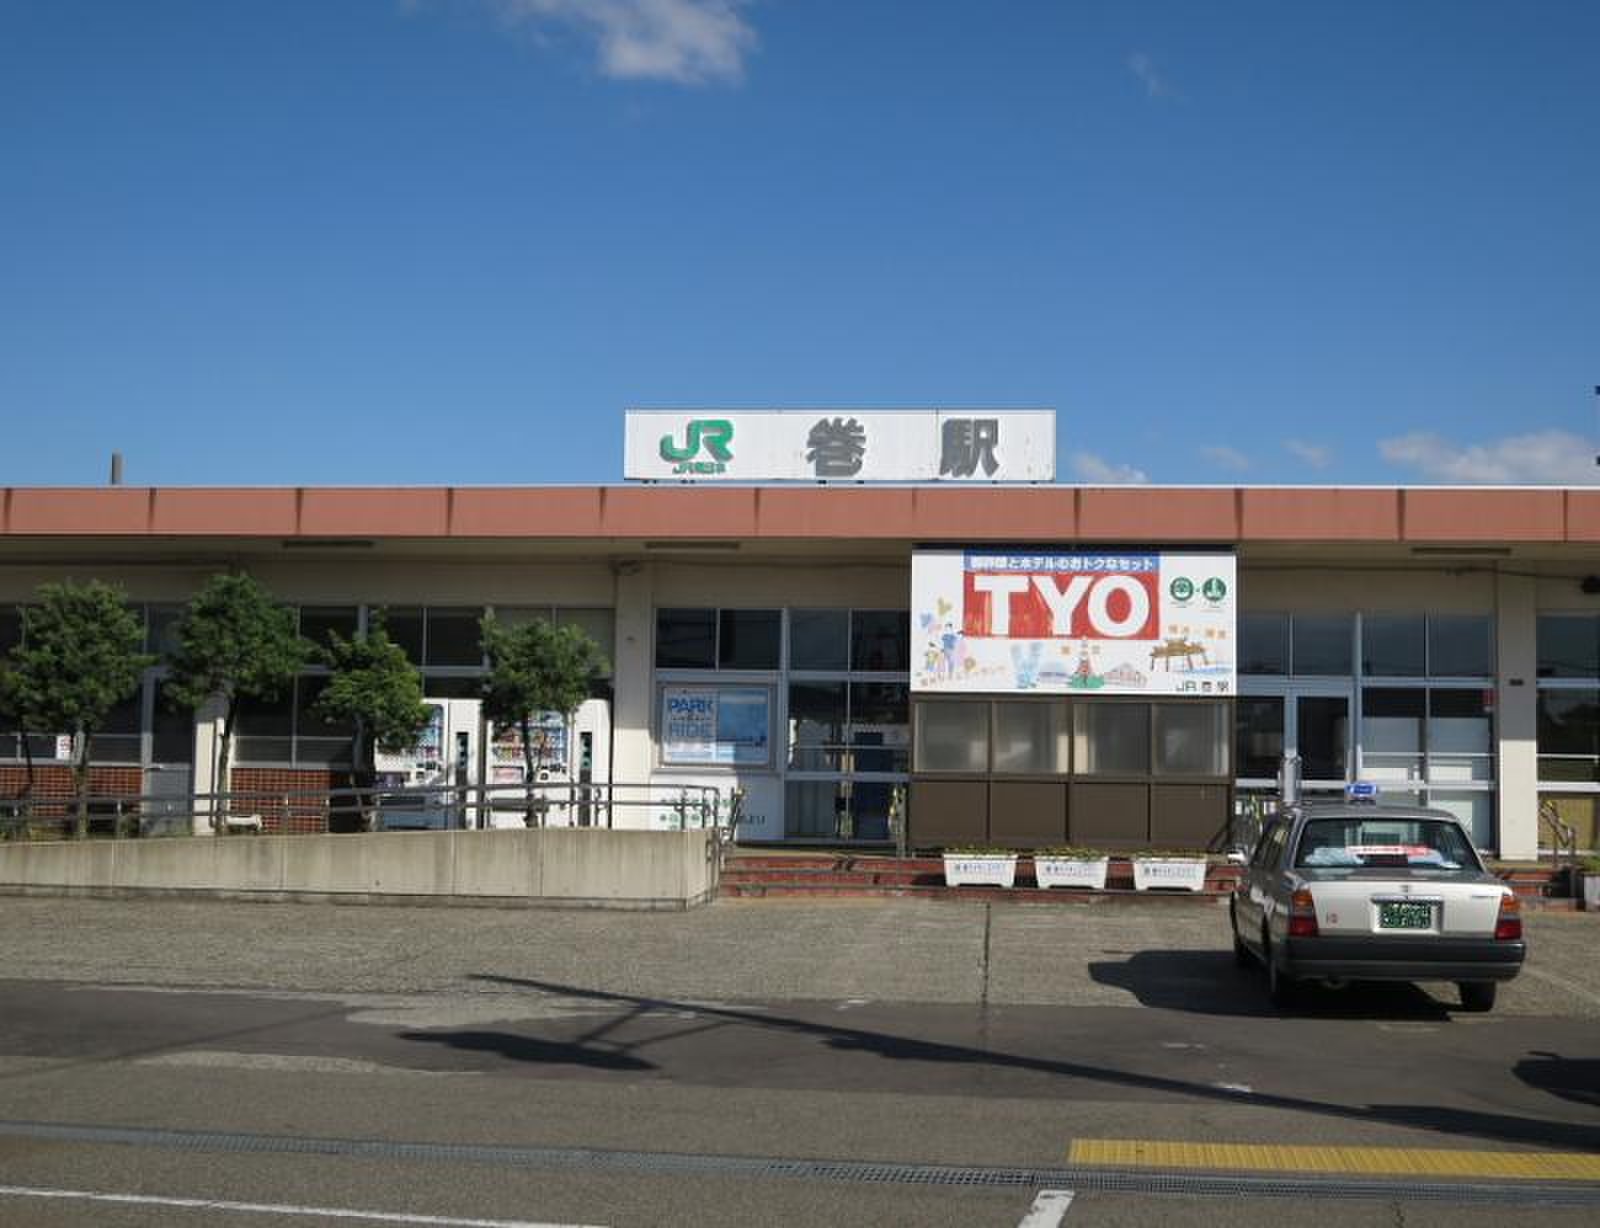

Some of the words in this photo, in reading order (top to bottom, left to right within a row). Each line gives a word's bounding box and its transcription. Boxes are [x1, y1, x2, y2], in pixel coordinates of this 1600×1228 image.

[660, 419, 734, 462] JR
[806, 416, 999, 478] 巻駅
[973, 574, 1151, 638] TYO
[667, 696, 713, 712] PARK
